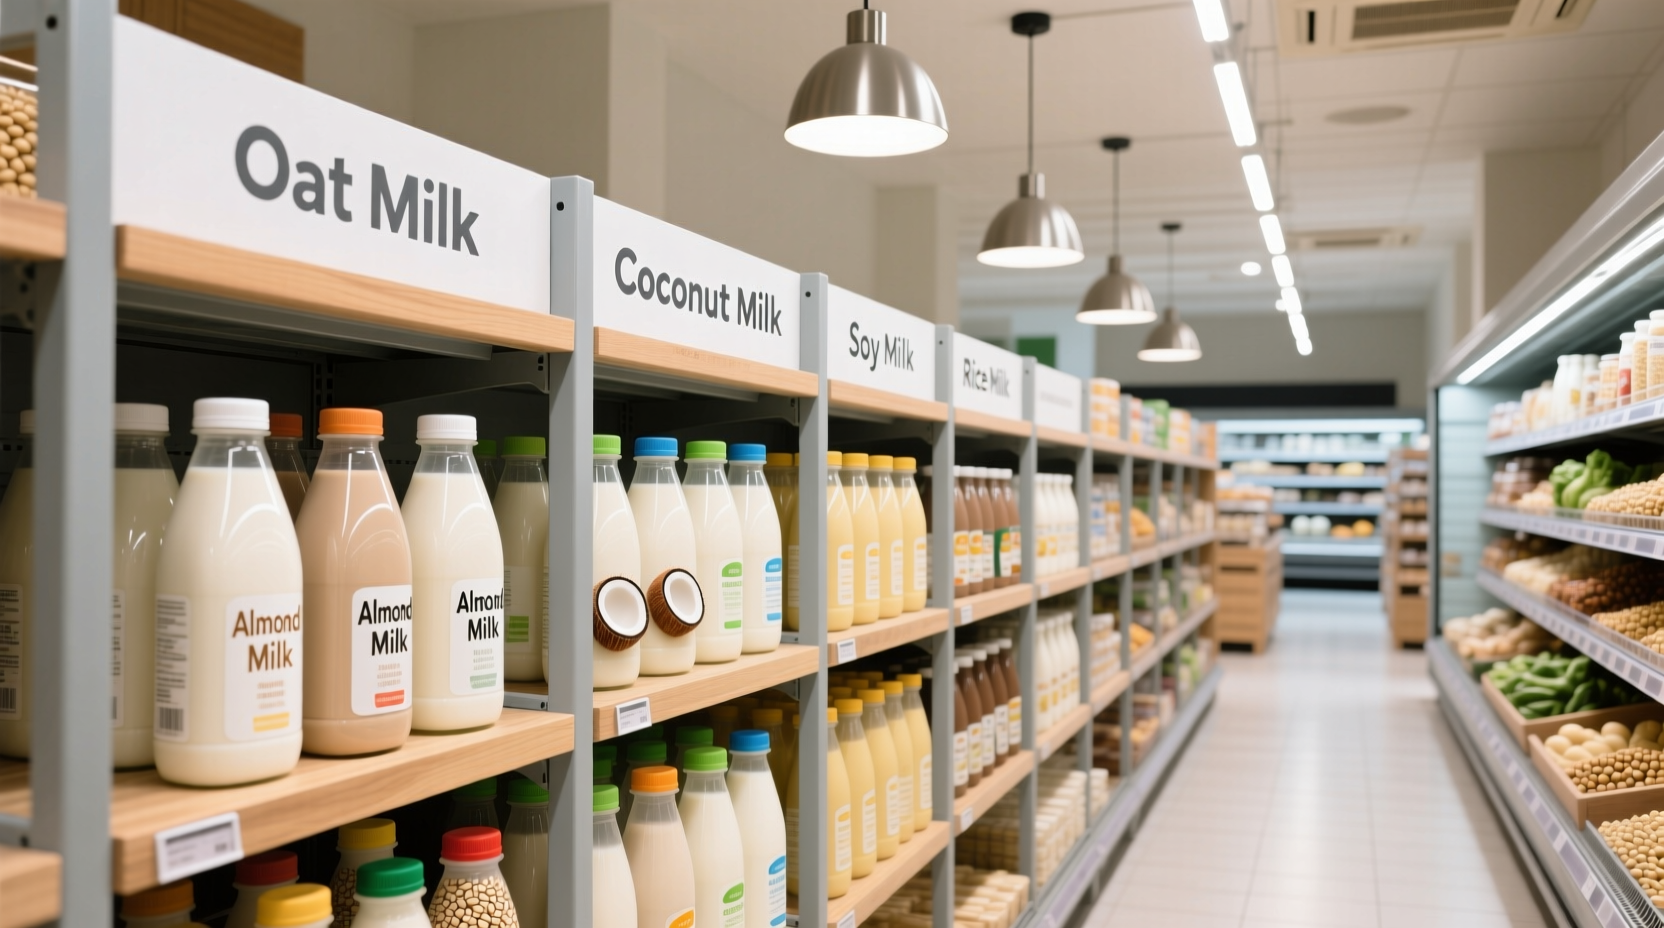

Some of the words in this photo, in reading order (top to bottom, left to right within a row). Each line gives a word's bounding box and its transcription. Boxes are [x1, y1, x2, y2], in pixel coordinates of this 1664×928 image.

[235, 124, 353, 222] Oat
[371, 163, 479, 256] Milk
[615, 247, 730, 322] Coconut
[737, 286, 782, 336] Milk
[849, 321, 880, 372] Soy
[884, 333, 914, 372] Milk
[963, 357, 988, 391] Rice
[232, 604, 301, 638] Almond
[357, 596, 412, 625] Almond
[371, 627, 408, 656] Milk
[468, 615, 499, 642] Milk
[248, 640, 293, 673] Milk
